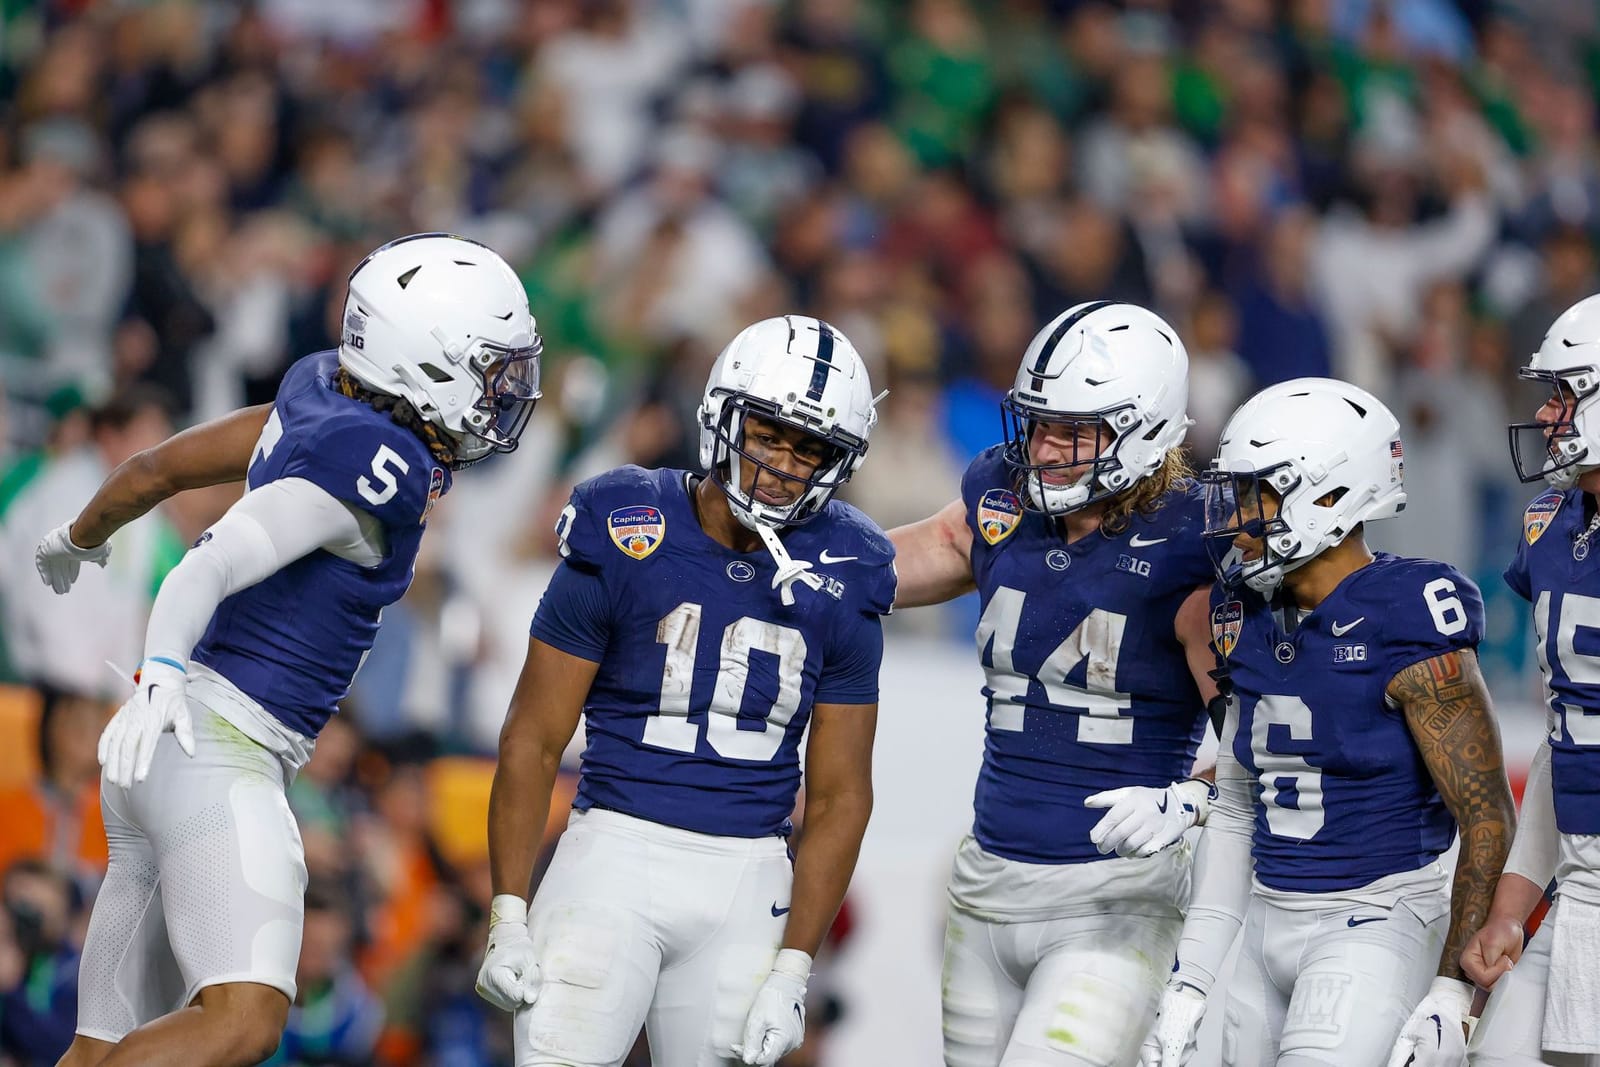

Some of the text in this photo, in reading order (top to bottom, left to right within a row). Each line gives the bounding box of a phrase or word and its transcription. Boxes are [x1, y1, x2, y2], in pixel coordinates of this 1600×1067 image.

[357, 443, 410, 506] 5
[641, 601, 808, 762] 10
[975, 585, 1135, 745] 44
[1423, 577, 1468, 637] 6
[1533, 590, 1600, 745] 15
[1250, 694, 1326, 840] 6
